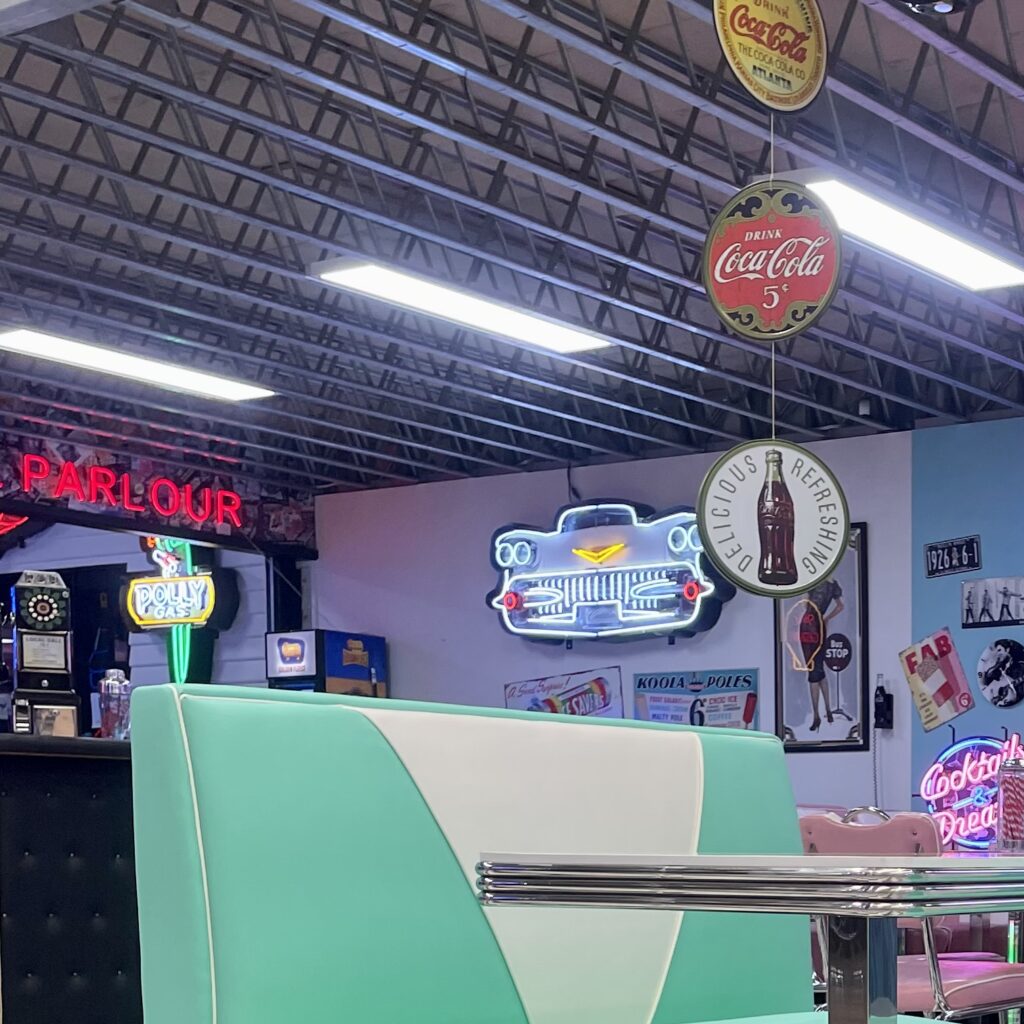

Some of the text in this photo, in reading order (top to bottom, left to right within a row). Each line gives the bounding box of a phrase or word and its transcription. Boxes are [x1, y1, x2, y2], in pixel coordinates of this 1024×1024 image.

[738, 42, 753, 57] THE
[744, 229, 782, 241] DRINK
[23, 454, 242, 528] PARLOUR
[711, 455, 757, 573] DELICIOUS
[791, 458, 839, 575] REFRESHING
[927, 548, 950, 571] 1926
[154, 605, 191, 619] GAS
[825, 648, 849, 658] STOP
[905, 635, 952, 675] FAB
[637, 674, 752, 689] KOOLA POLES
[931, 802, 999, 845] Drea
